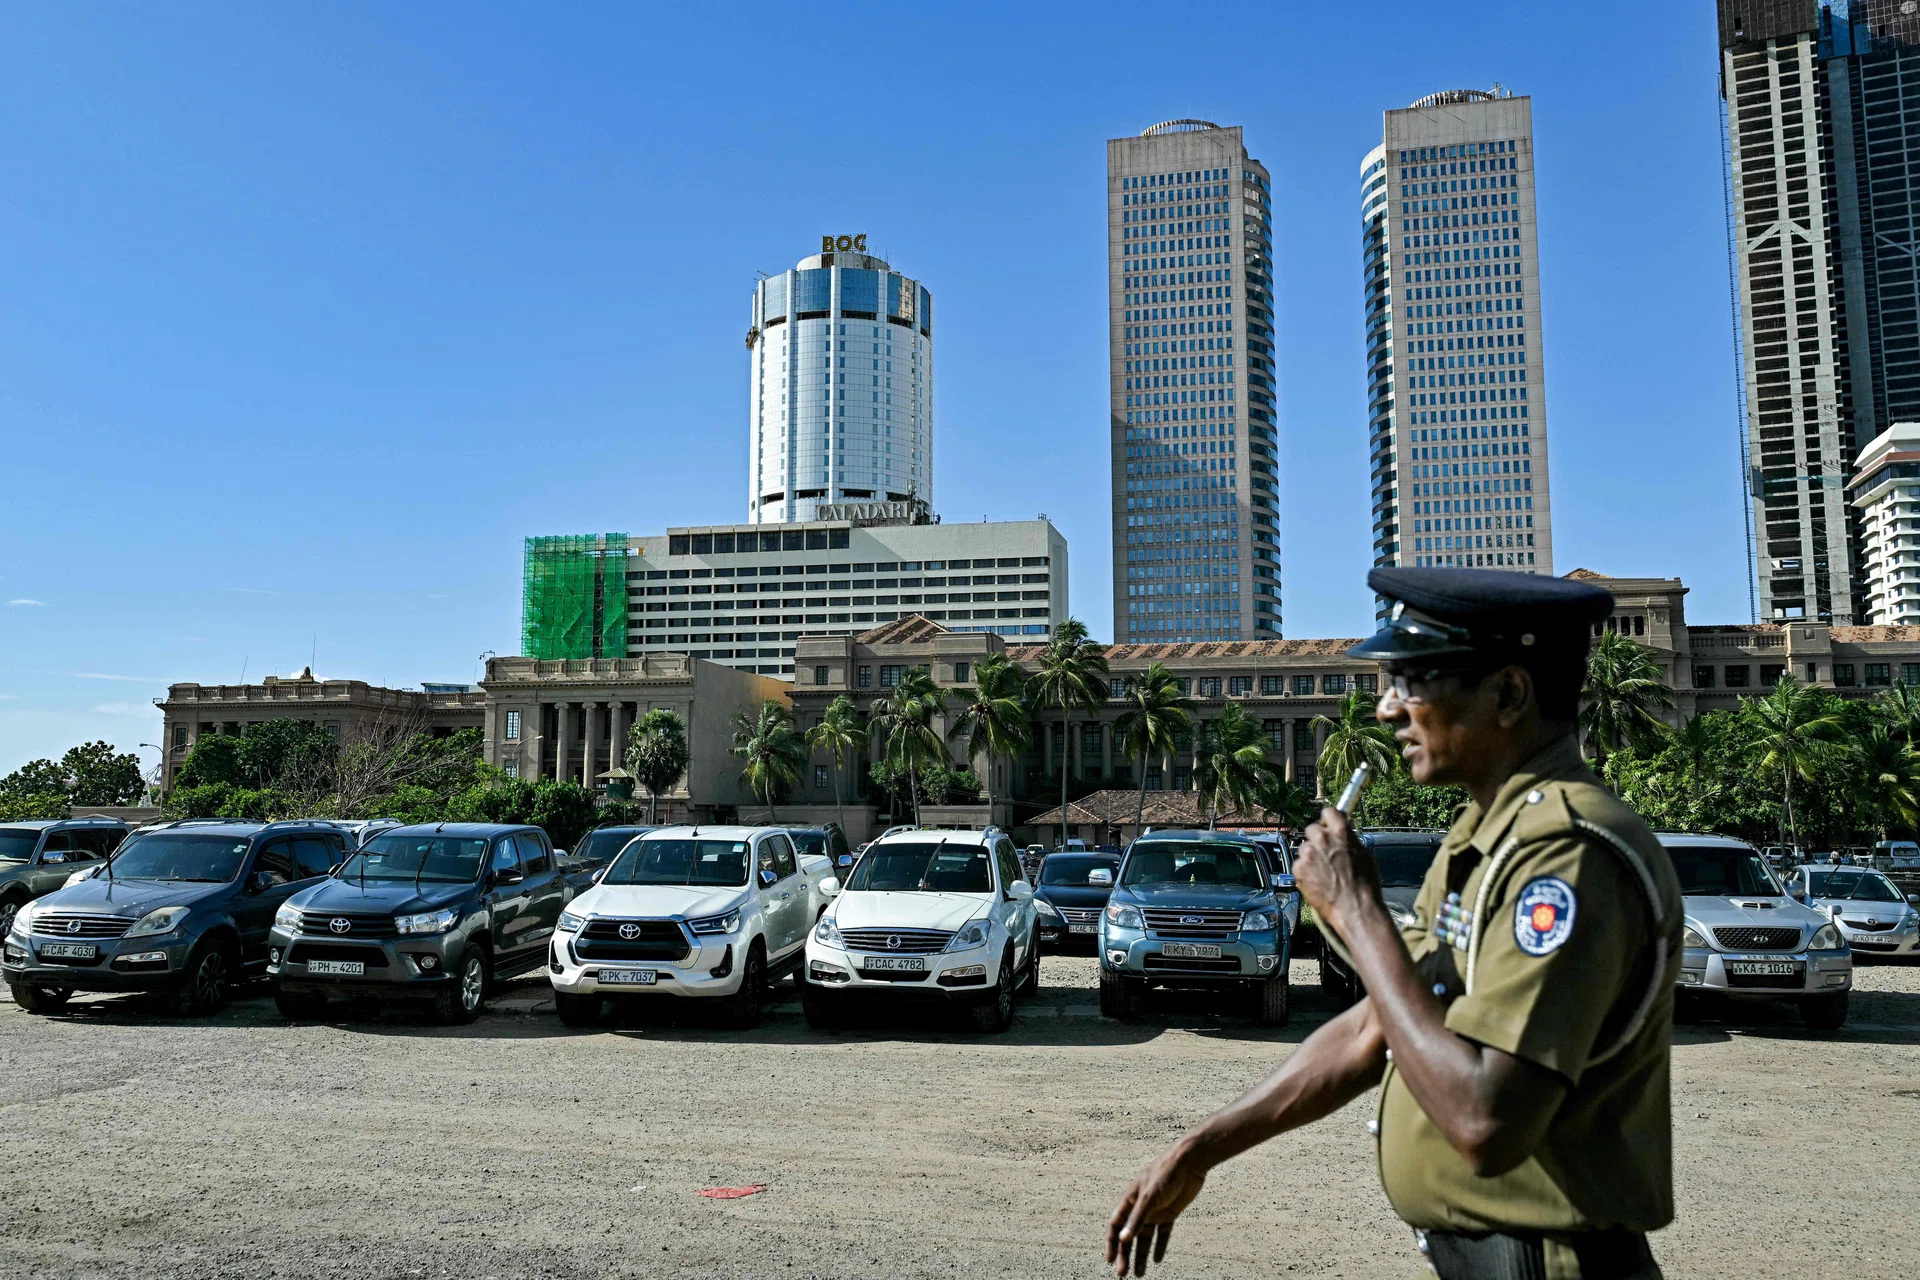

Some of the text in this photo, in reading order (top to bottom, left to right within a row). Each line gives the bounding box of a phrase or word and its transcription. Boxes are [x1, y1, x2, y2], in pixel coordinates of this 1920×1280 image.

[822, 233, 866, 252] BOC
[51, 945, 95, 957] CAF 4030
[1173, 945, 1186, 955] KY
[317, 962, 330, 972] PH
[339, 963, 363, 974] 4201
[875, 959, 922, 970] CAC 4782
[1743, 963, 1757, 973] KA
[1767, 964, 1792, 974] 1016
[608, 971, 621, 981] PK
[630, 972, 654, 982] 7037
